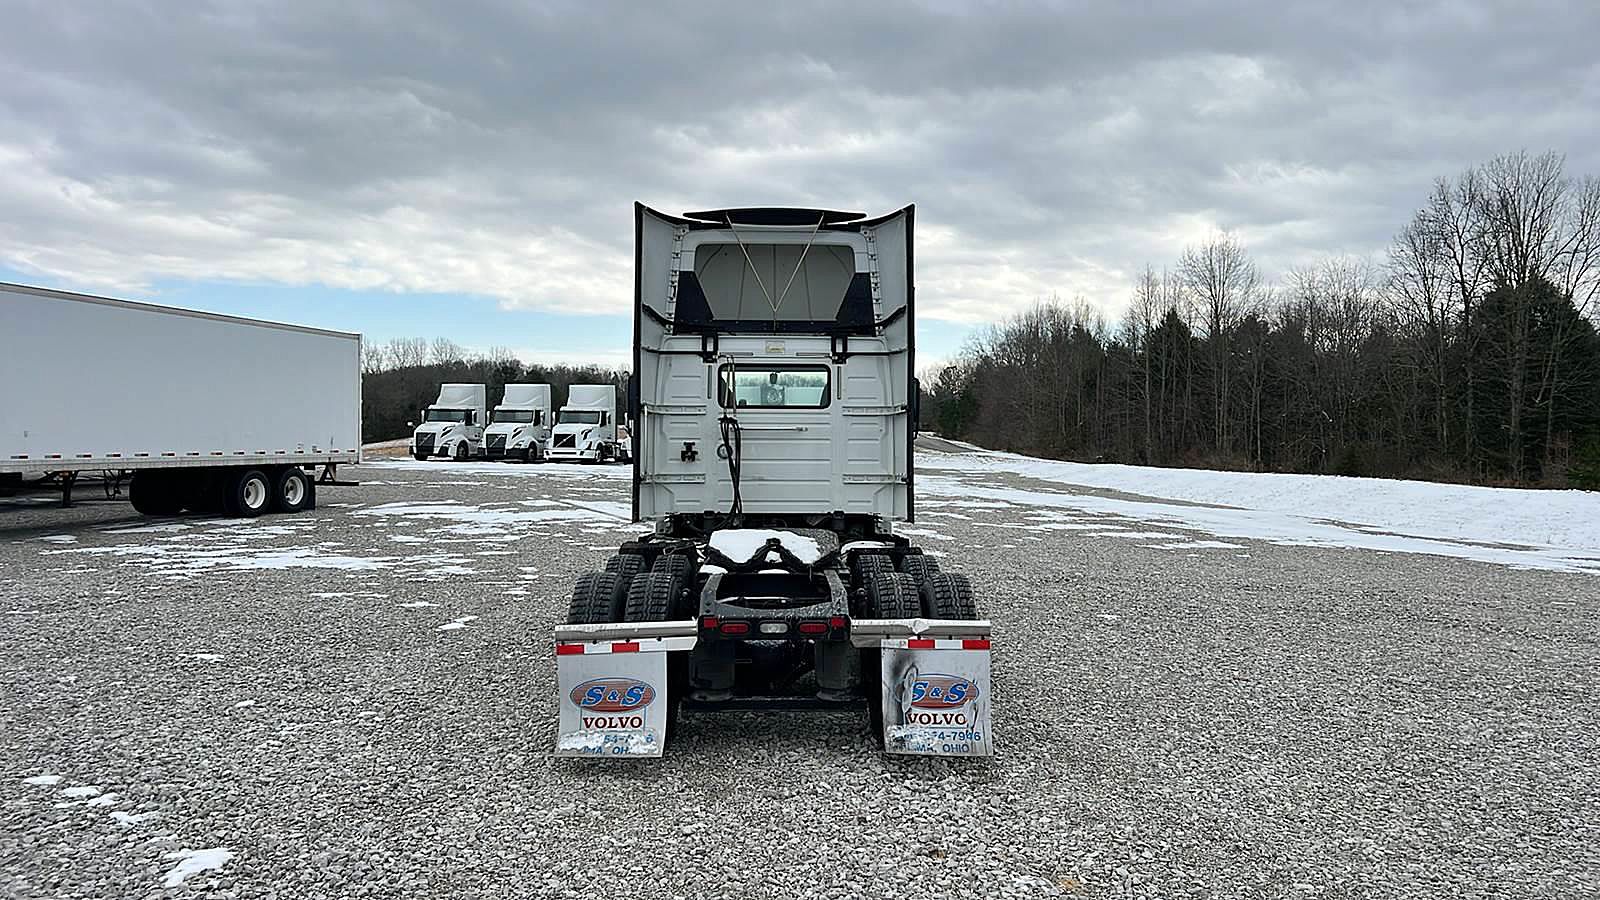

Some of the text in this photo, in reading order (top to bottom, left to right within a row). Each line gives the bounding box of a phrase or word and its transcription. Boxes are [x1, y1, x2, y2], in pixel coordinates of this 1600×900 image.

[583, 716, 643, 728] VOLVO
[907, 713, 966, 725] VOLVO
[612, 746, 631, 755] OH
[942, 743, 970, 753] OHIO
